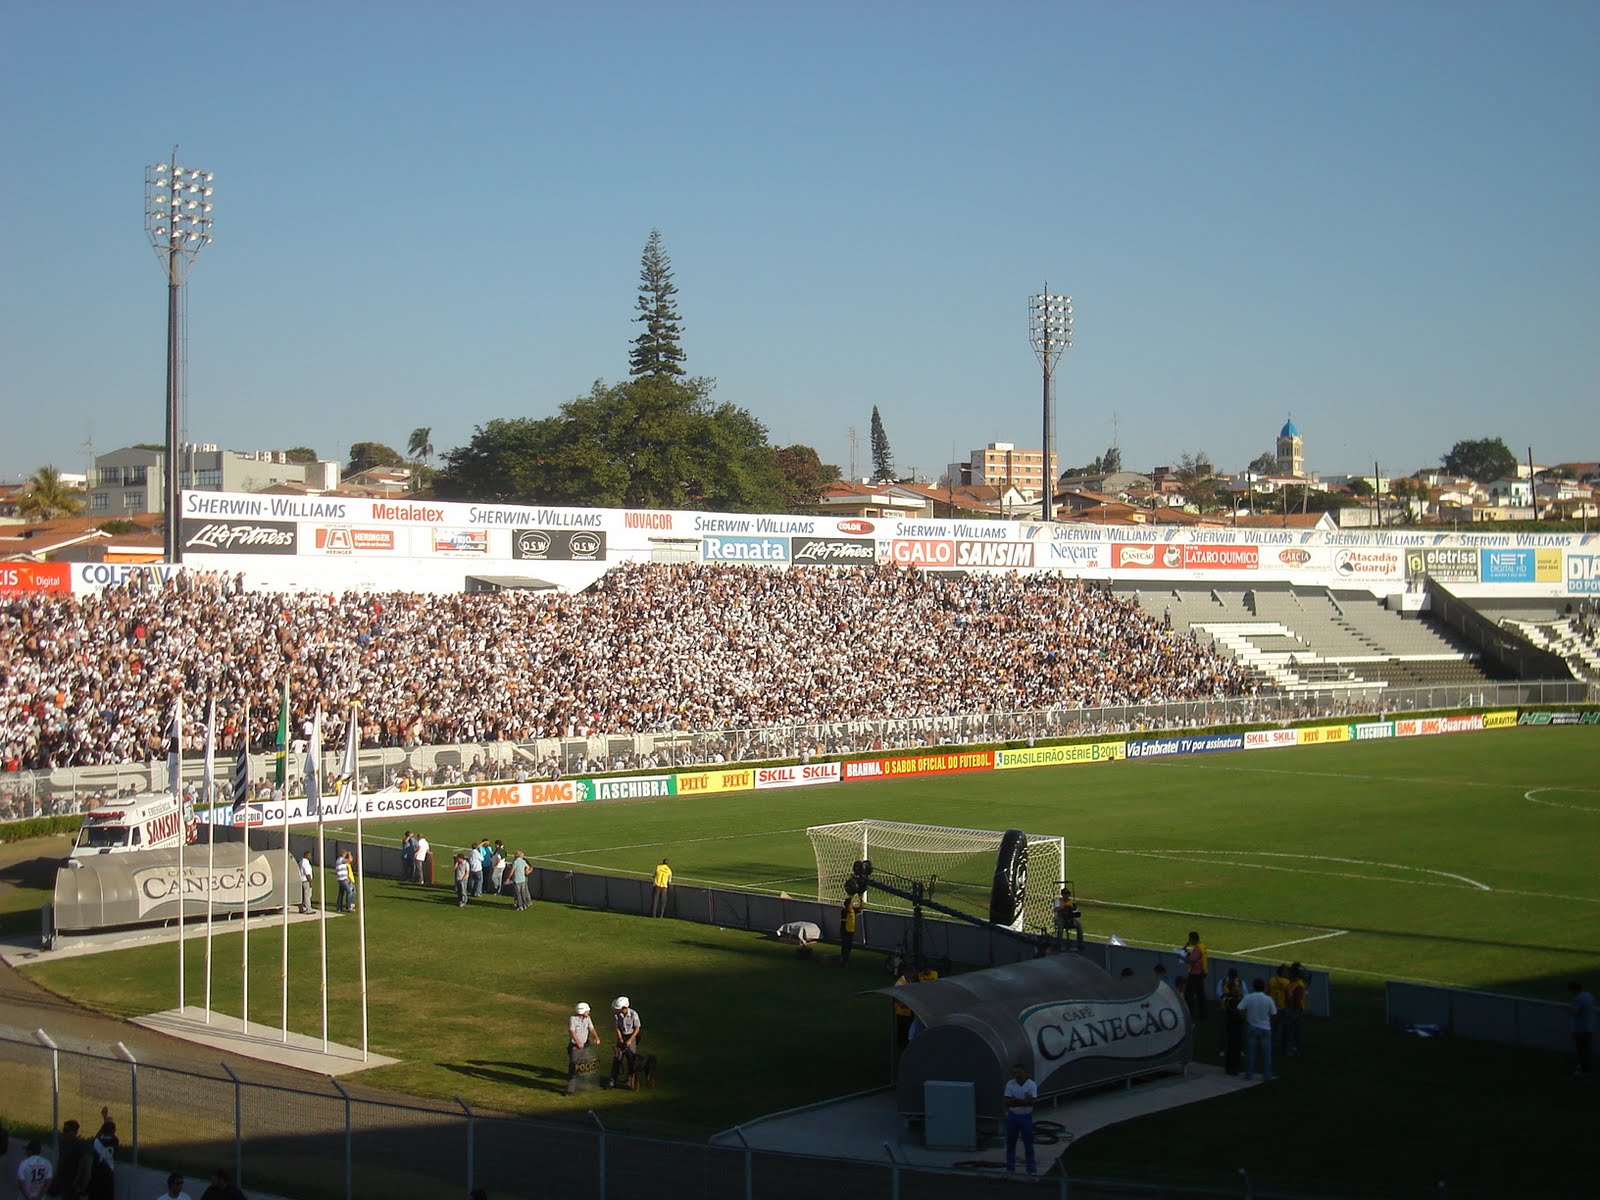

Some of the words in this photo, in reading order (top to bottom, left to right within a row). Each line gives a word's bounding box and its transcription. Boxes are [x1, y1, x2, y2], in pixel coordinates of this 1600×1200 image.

[372, 503, 444, 522] Metalatex
[624, 512, 673, 530] NOVACOR
[1053, 526, 1101, 541] SHERWIN
[1106, 527, 1158, 542] WILLIAMS
[1189, 530, 1236, 543] SHERWIN
[1244, 530, 1293, 544] WILLIAMS
[1324, 532, 1370, 546] SHERWIN
[1375, 532, 1426, 546] WILLIAMS
[1459, 534, 1509, 547] SHERWIN
[1516, 534, 1571, 547] WILLIAMS
[706, 538, 787, 561] Renata
[894, 541, 950, 563] GALO
[957, 541, 1035, 568] SANSIM
[1050, 542, 1099, 564] Nexcare
[1186, 551, 1219, 563] LATARO
[1349, 552, 1398, 562] Atacadão
[1427, 550, 1477, 564] eletrisa
[1087, 560, 1099, 568] 3M
[1490, 553, 1527, 565] NET
[1354, 562, 1397, 575] Guarujá
[1490, 565, 1515, 573] DIGITAL
[36, 576, 60, 588] Digital
[1569, 580, 1583, 591] DO
[1441, 715, 1483, 732] Guaravita
[1579, 711, 1600, 724] H
[1397, 722, 1416, 735] BMG
[1421, 720, 1439, 734] BMG
[1246, 733, 1270, 744] SKILL
[1273, 731, 1296, 742] SKILL
[1003, 748, 1064, 765] BRASILEIRÃO
[1065, 747, 1091, 761] SÉRIE
[1092, 745, 1100, 760] B
[1100, 745, 1118, 758] 2011
[1127, 742, 1141, 757] Via
[1141, 740, 1180, 756] Embratel
[1181, 740, 1193, 751] TV
[1191, 741, 1206, 753] por
[1206, 738, 1242, 749] assinatura
[846, 761, 883, 777] BRAHMA.
[884, 761, 890, 774] O
[892, 759, 917, 774] SABOR
[917, 756, 947, 772] OFICIAL
[948, 755, 958, 769] DO
[959, 753, 992, 768] FUTEBOL.
[680, 774, 709, 792] PITÚ
[722, 771, 750, 788] PITÚ
[759, 769, 796, 782] SKILL
[803, 765, 838, 778] SKILL
[477, 786, 520, 807] BMG
[532, 783, 573, 803] BMG
[592, 774, 671, 800] TASCHIBRA
[366, 799, 374, 811] É
[377, 796, 446, 811] CASCOREZ
[449, 795, 470, 806] CASCOLA
[143, 868, 267, 900] CANECÃO
[1062, 1006, 1095, 1023] CAFÉ
[1036, 1003, 1179, 1062] CANECÃO
[31, 1167, 45, 1184] 15
